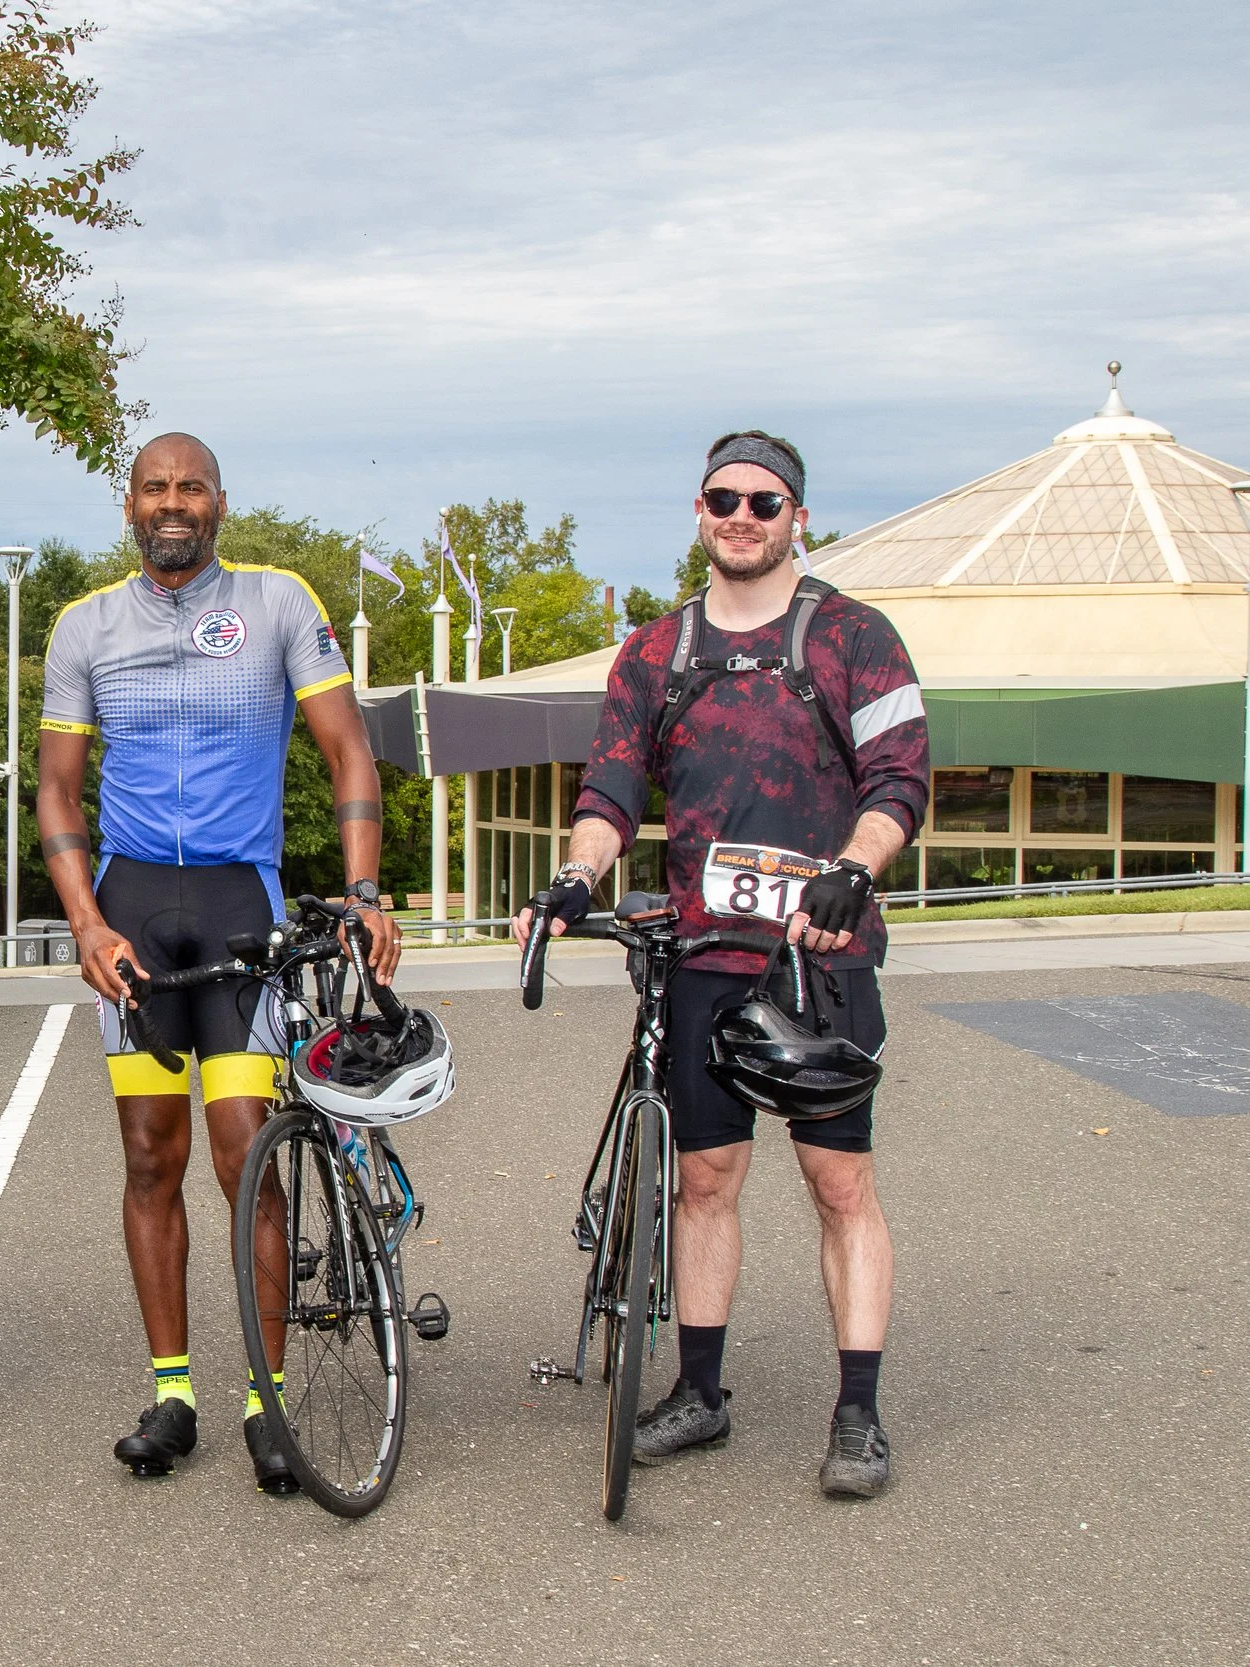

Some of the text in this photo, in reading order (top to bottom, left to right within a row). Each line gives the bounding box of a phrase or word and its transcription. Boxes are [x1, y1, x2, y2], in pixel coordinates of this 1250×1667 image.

[49, 722, 73, 730] HONOR
[716, 854, 756, 867] BREAK
[350, 940, 365, 974] SRAM
[155, 1376, 190, 1386] ESPEC
